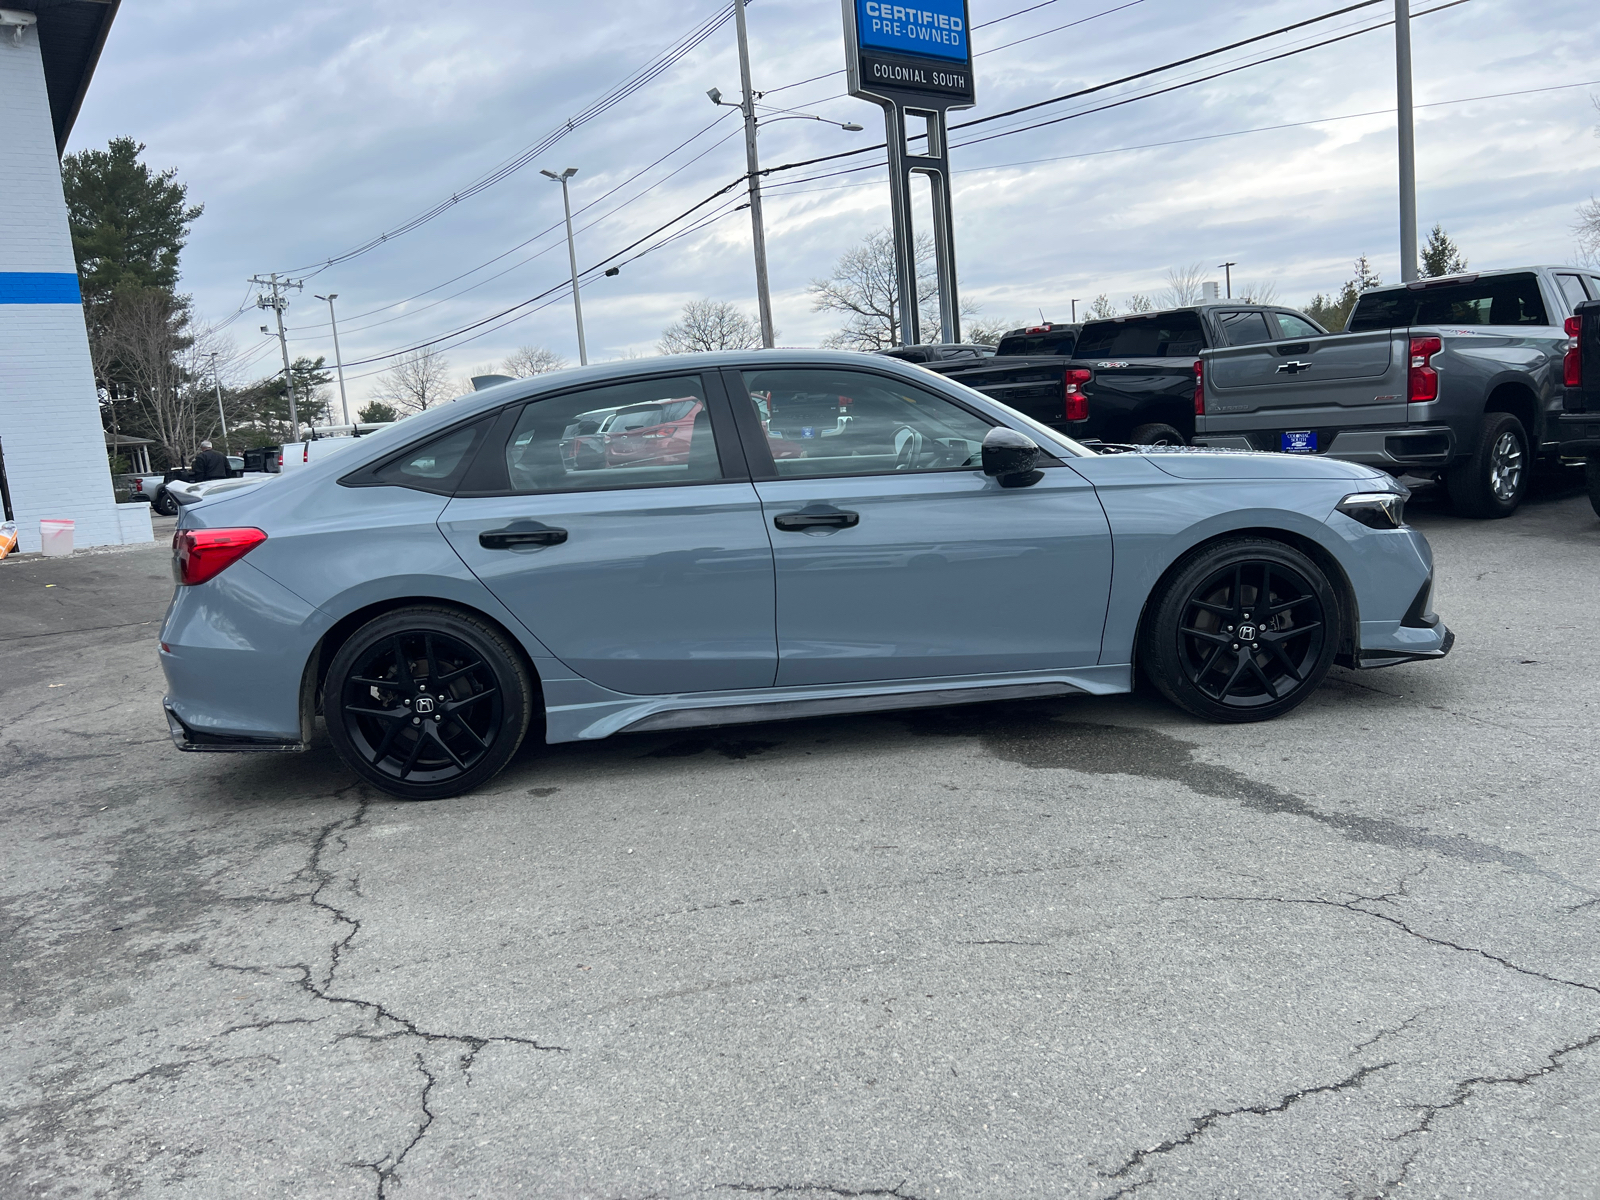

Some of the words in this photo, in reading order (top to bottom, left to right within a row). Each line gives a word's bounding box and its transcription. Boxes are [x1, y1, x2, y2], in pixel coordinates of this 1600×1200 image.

[866, 2, 962, 31] CERTIFIED
[872, 19, 959, 45] PRE-OWNED
[873, 63, 927, 83] COLONIAL
[933, 72, 965, 89] SOUTH
